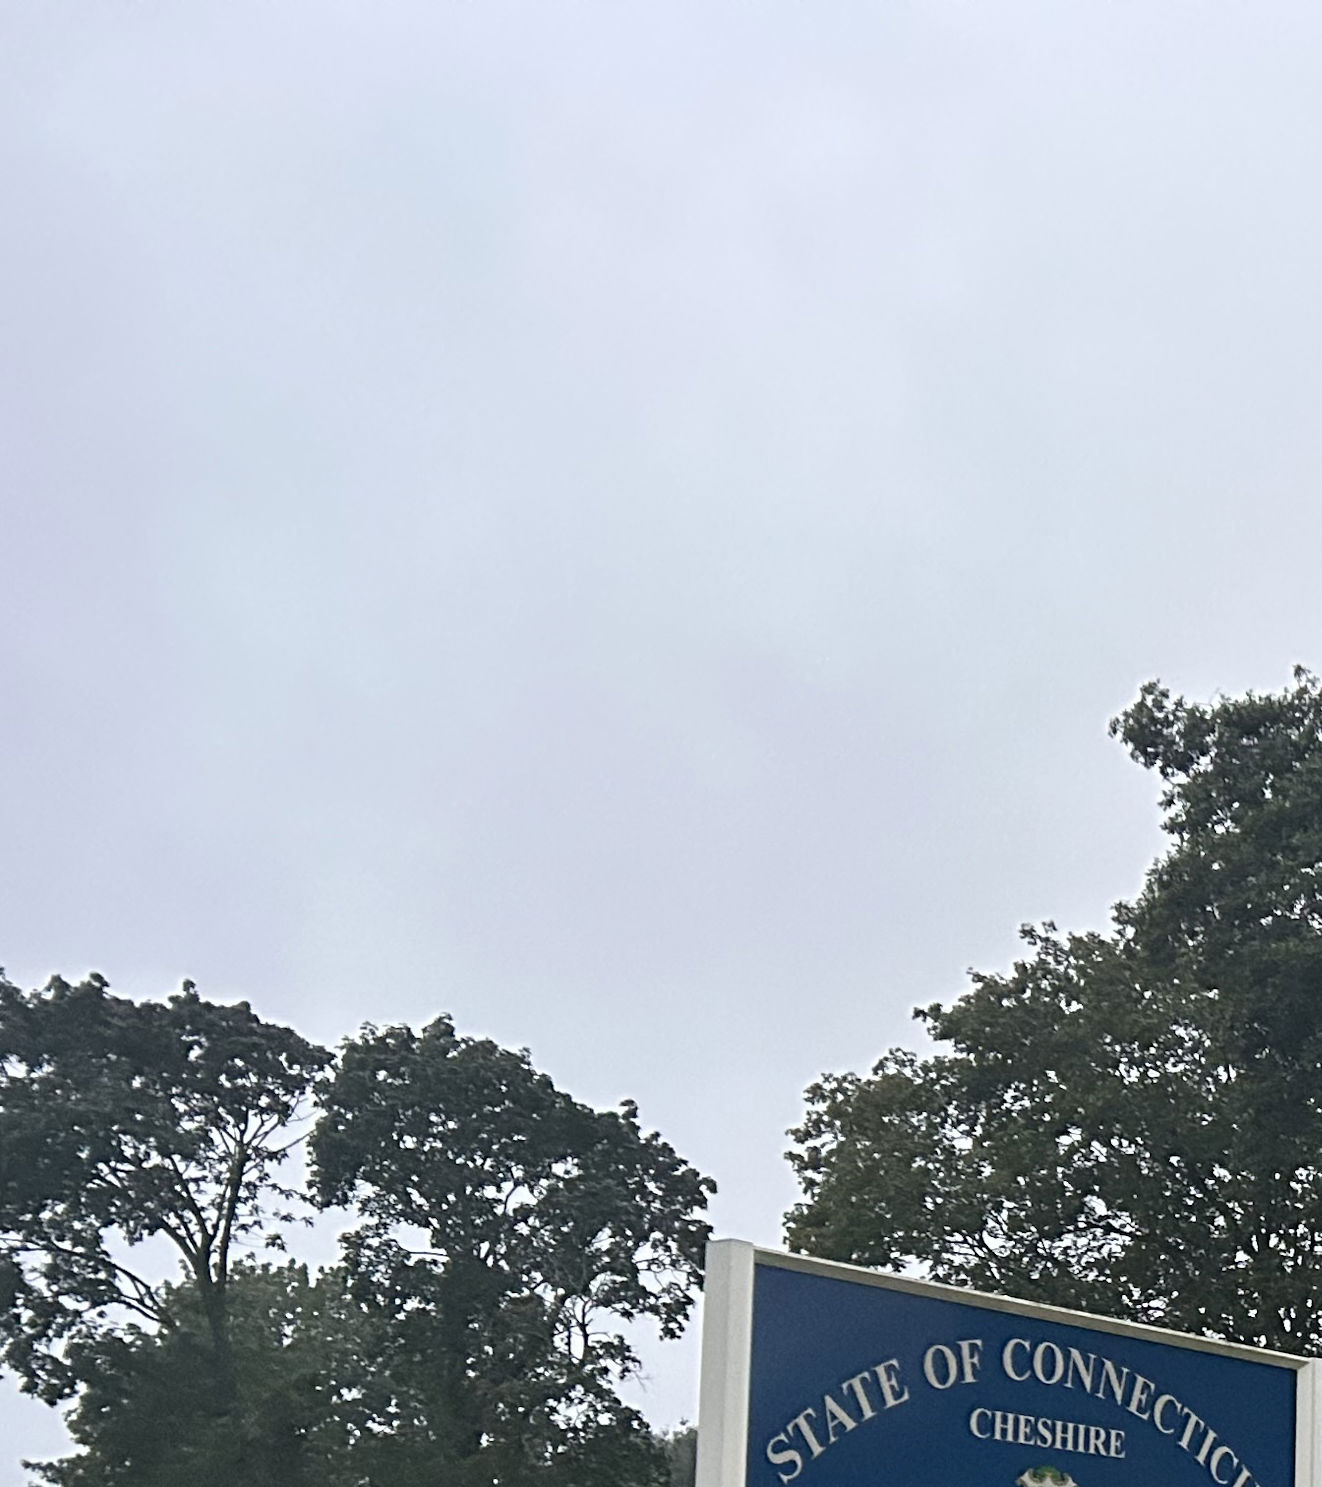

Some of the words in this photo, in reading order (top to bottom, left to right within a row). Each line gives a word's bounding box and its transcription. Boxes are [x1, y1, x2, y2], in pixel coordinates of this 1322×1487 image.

[766, 1358, 909, 1484] STATE
[924, 1339, 983, 1389] OF
[969, 1407, 1126, 1459] CHESHIRE
